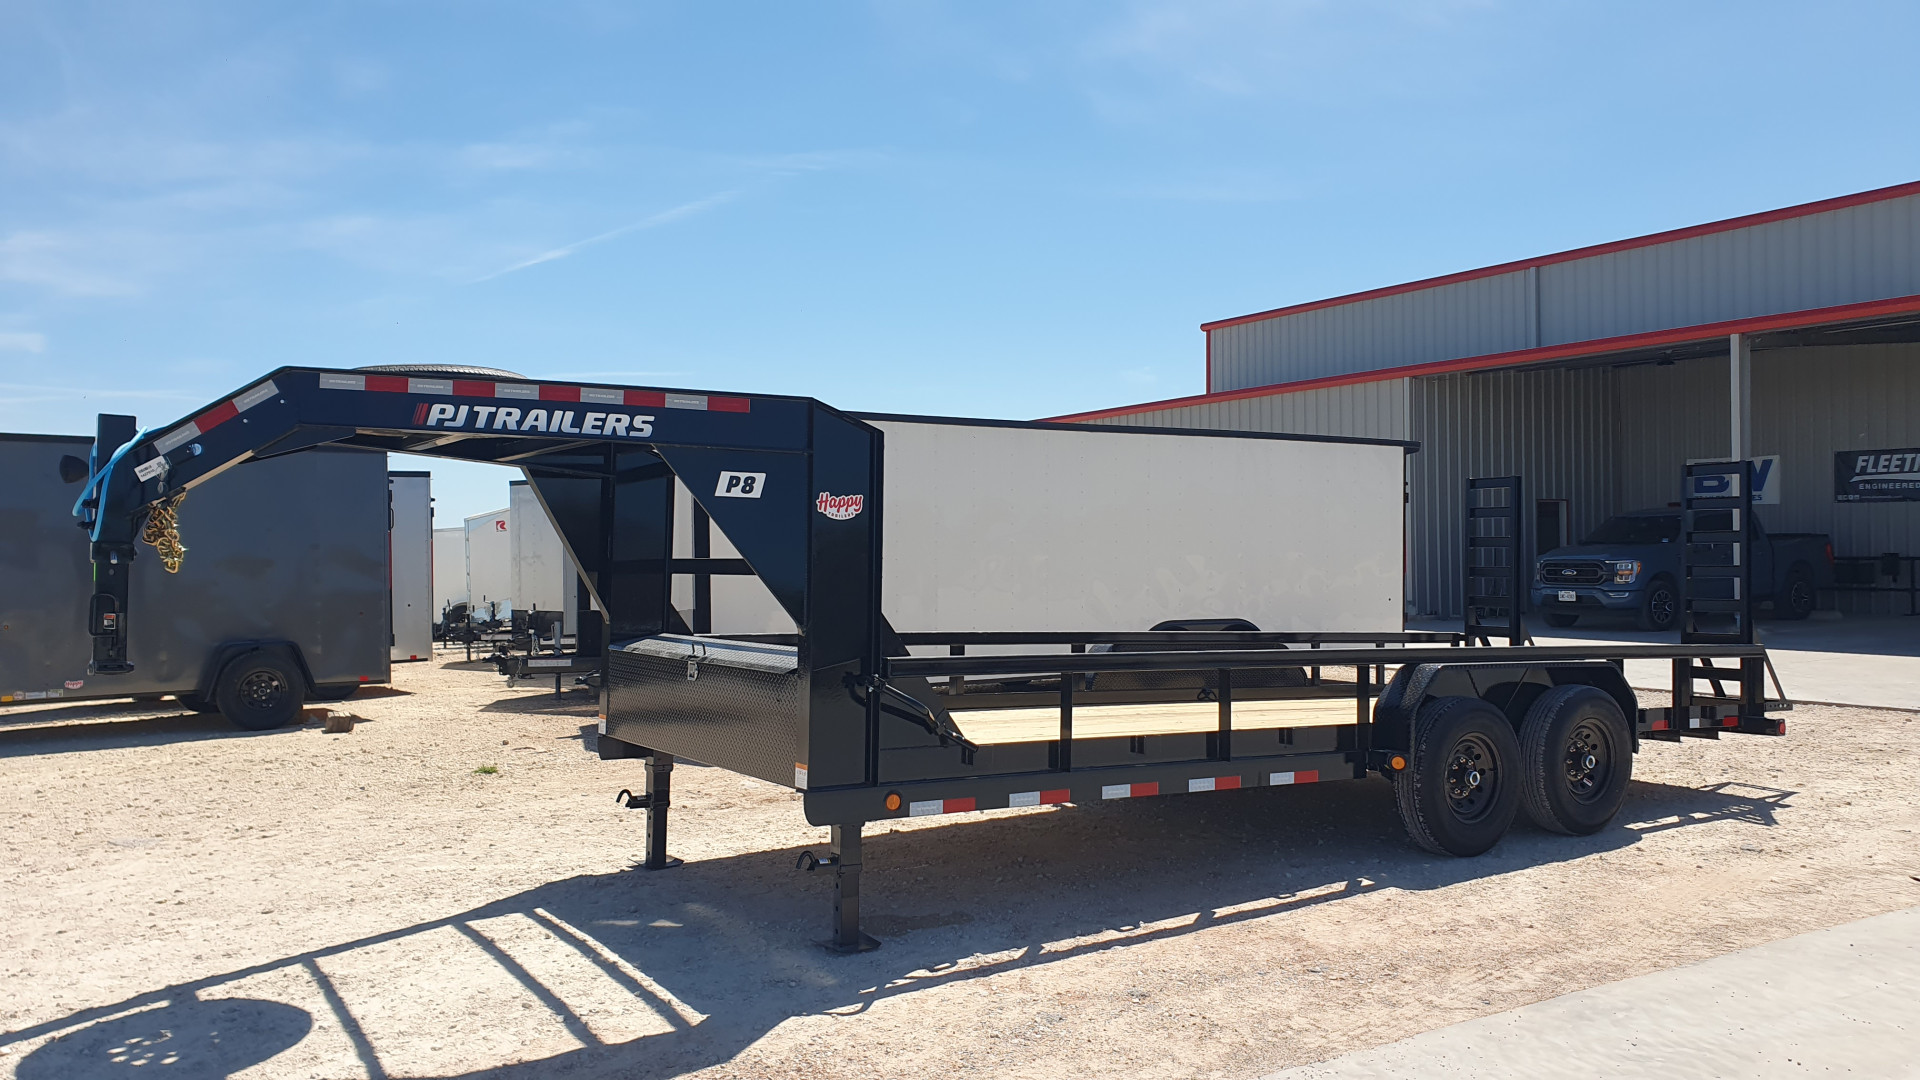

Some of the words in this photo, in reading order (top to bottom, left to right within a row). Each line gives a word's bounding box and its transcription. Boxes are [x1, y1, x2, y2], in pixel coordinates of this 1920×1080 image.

[473, 405, 656, 438] TRAILERS
[725, 475, 757, 495] P8
[818, 493, 863, 513] Happy
